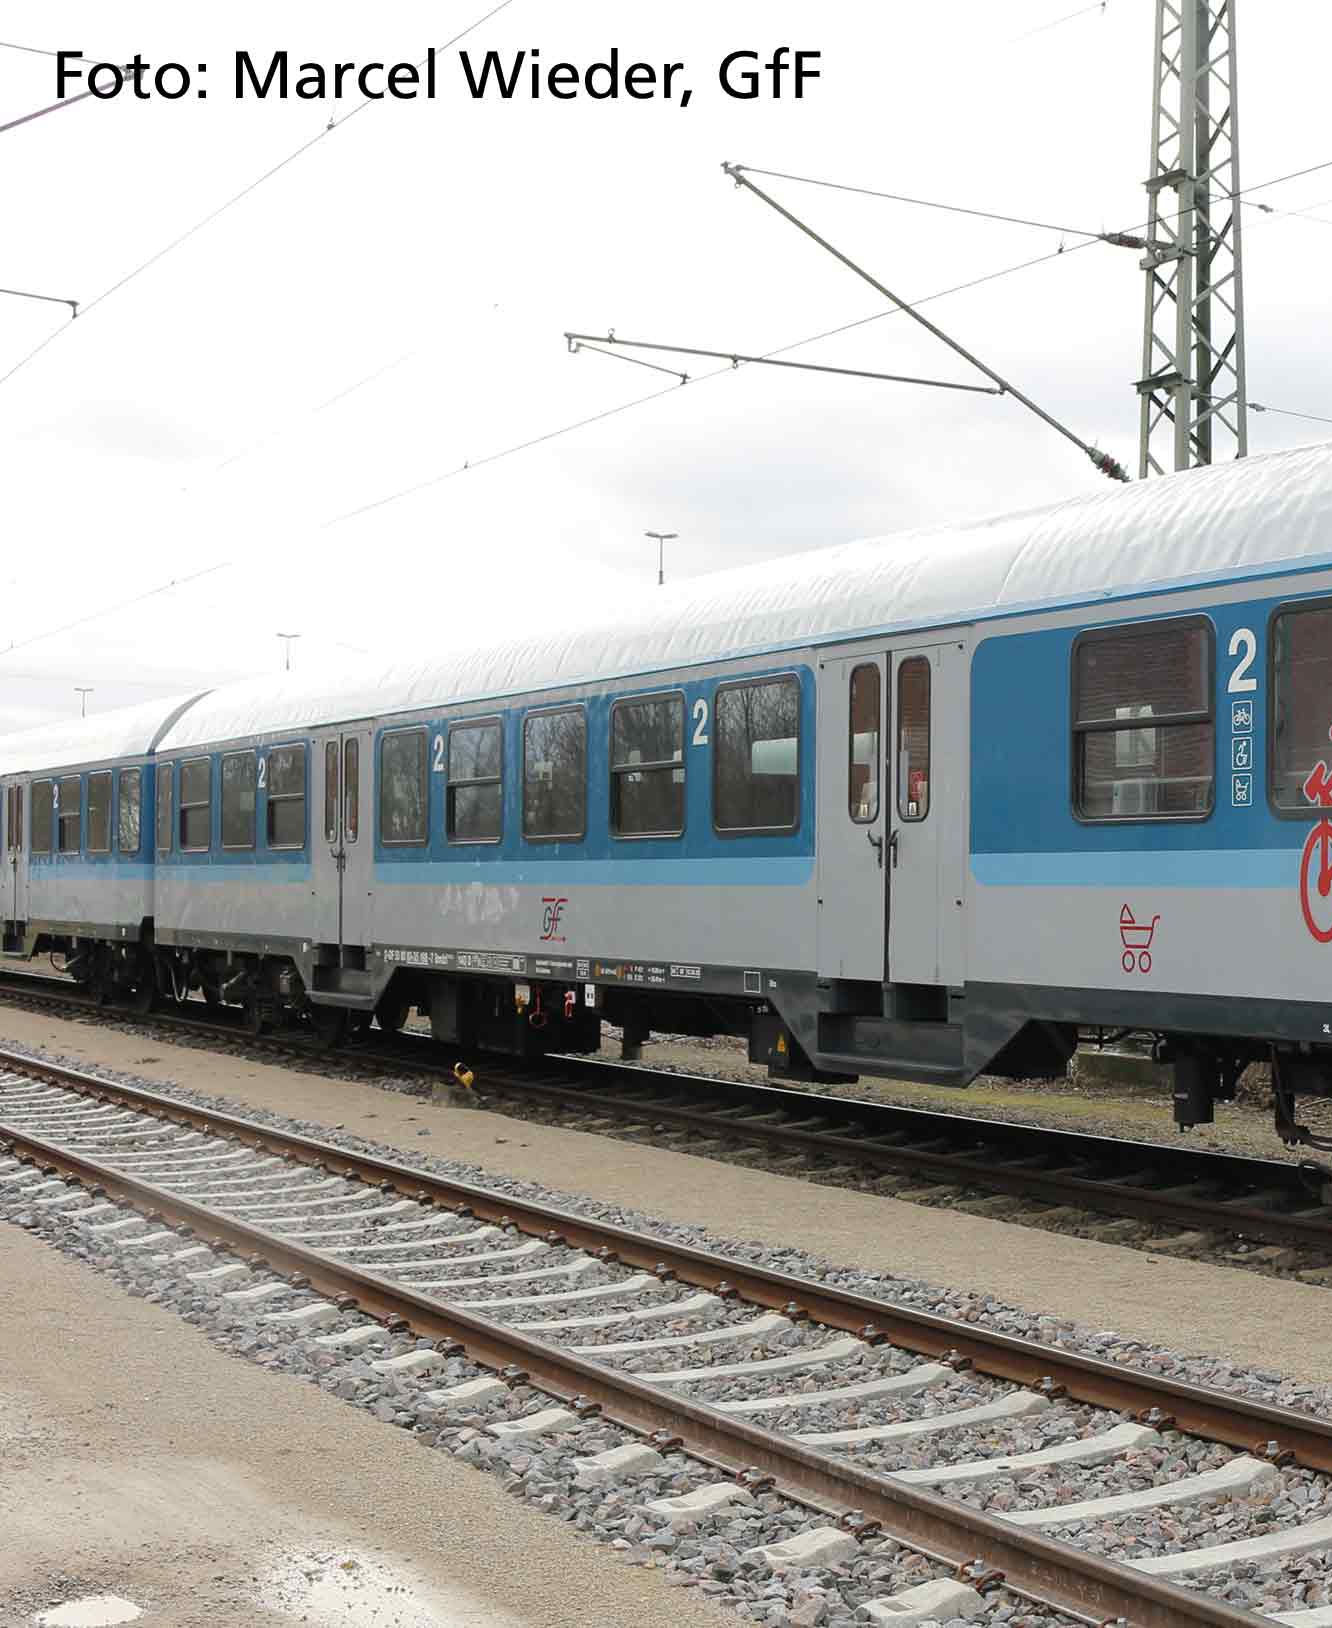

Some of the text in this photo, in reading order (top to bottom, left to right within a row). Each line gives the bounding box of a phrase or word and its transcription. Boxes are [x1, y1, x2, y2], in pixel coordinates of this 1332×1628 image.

[1227, 628, 1258, 693] 2
[692, 698, 709, 745] 2
[258, 757, 266, 788] 2
[433, 734, 445, 772] 2
